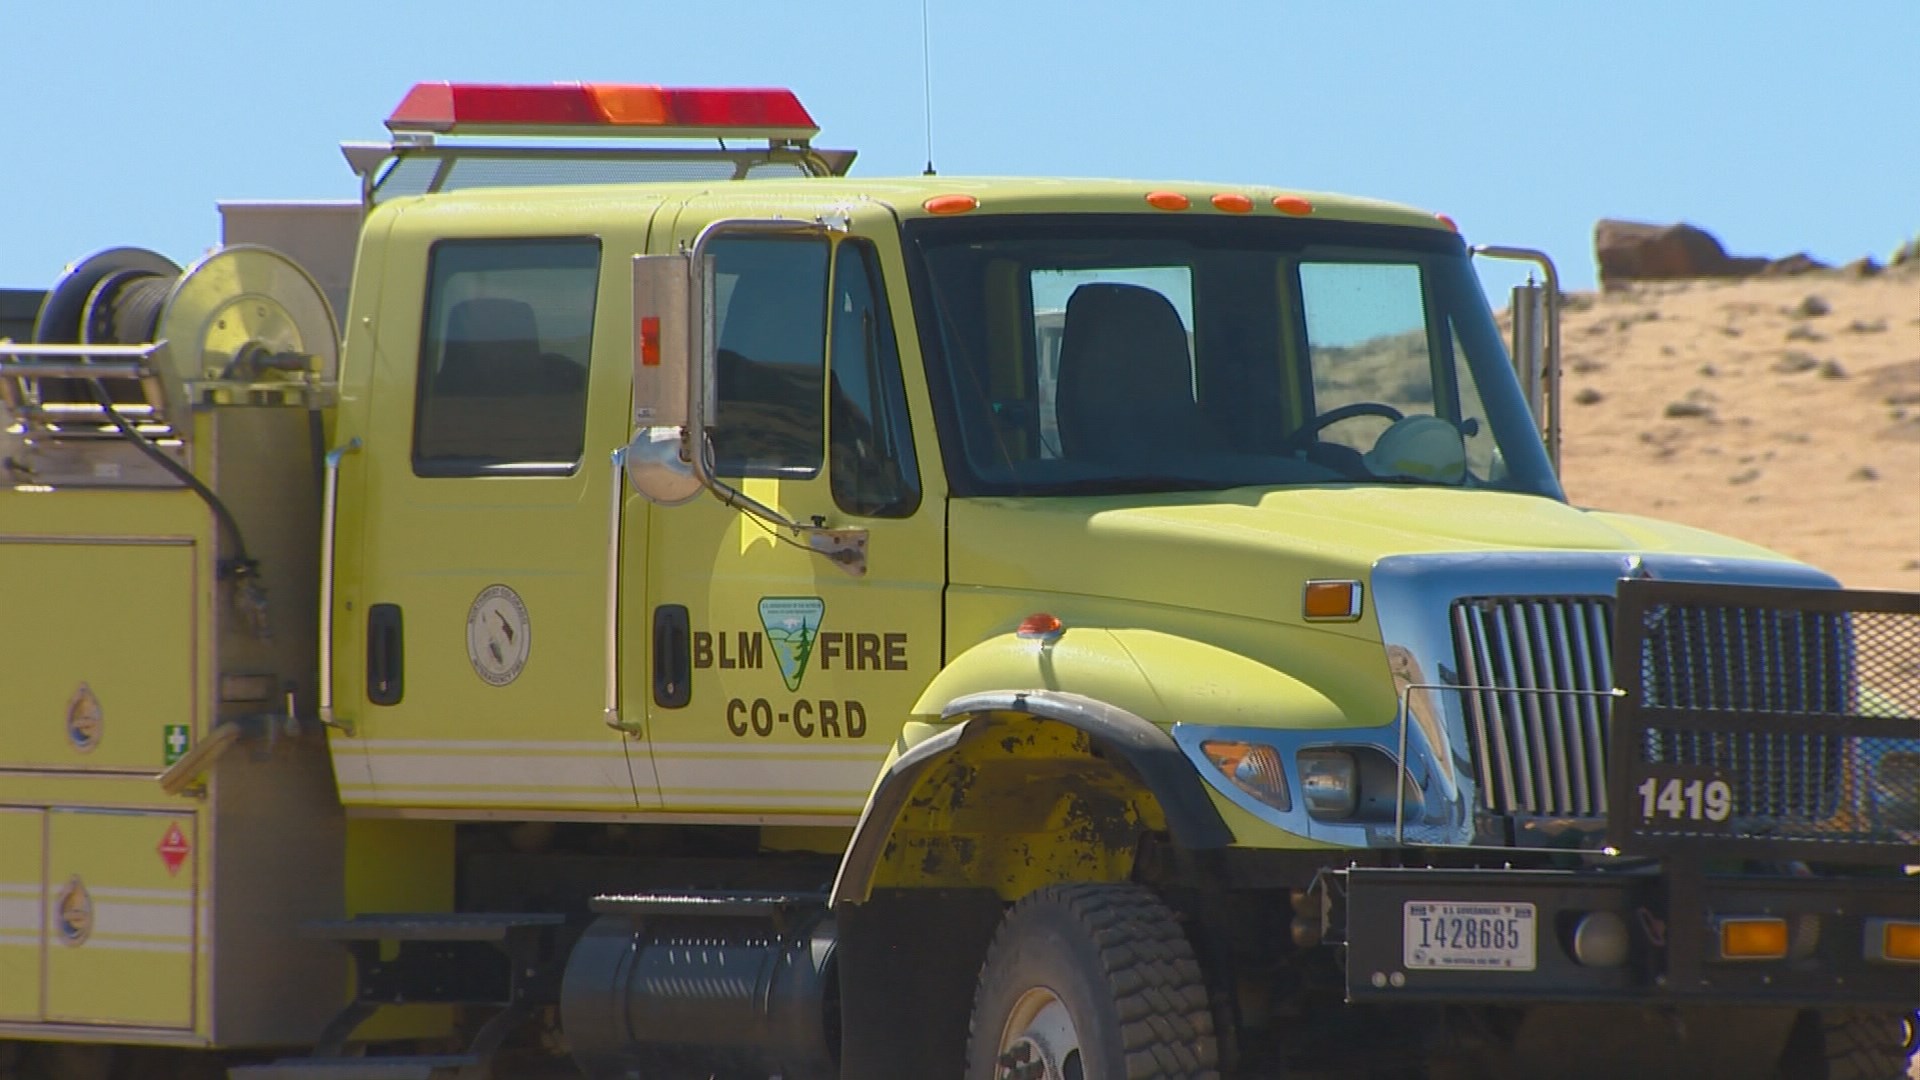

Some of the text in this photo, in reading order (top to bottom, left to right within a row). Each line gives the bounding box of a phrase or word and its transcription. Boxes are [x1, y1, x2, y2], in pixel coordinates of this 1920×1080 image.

[694, 631, 908, 671] BLM FIRE
[726, 698, 867, 738] CO-CRD
[1638, 777, 1732, 822] 1419
[1419, 918, 1519, 949] I428685
